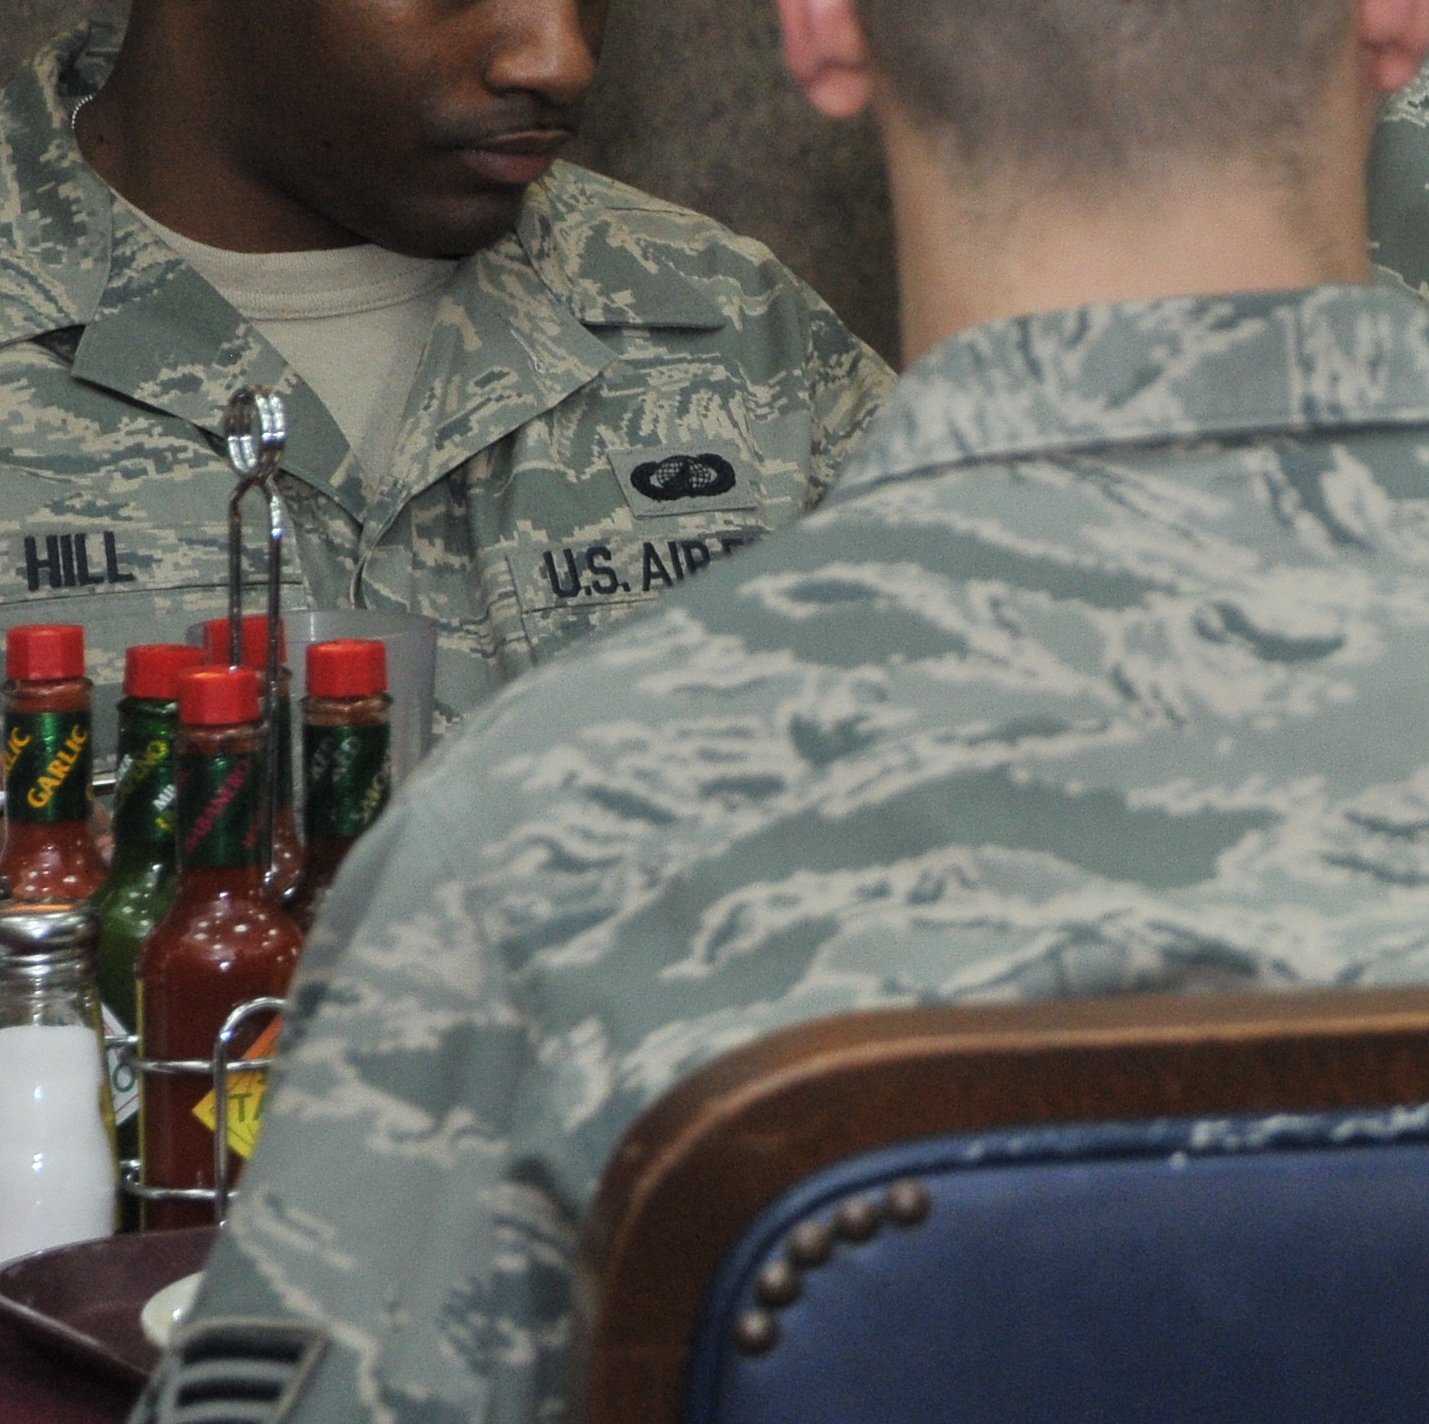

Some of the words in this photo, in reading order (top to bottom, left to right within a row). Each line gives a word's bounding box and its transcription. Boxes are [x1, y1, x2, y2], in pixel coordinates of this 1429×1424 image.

[24, 530, 136, 592] HILL
[543, 545, 631, 599] U.S.
[27, 725, 88, 808] GARLIC
